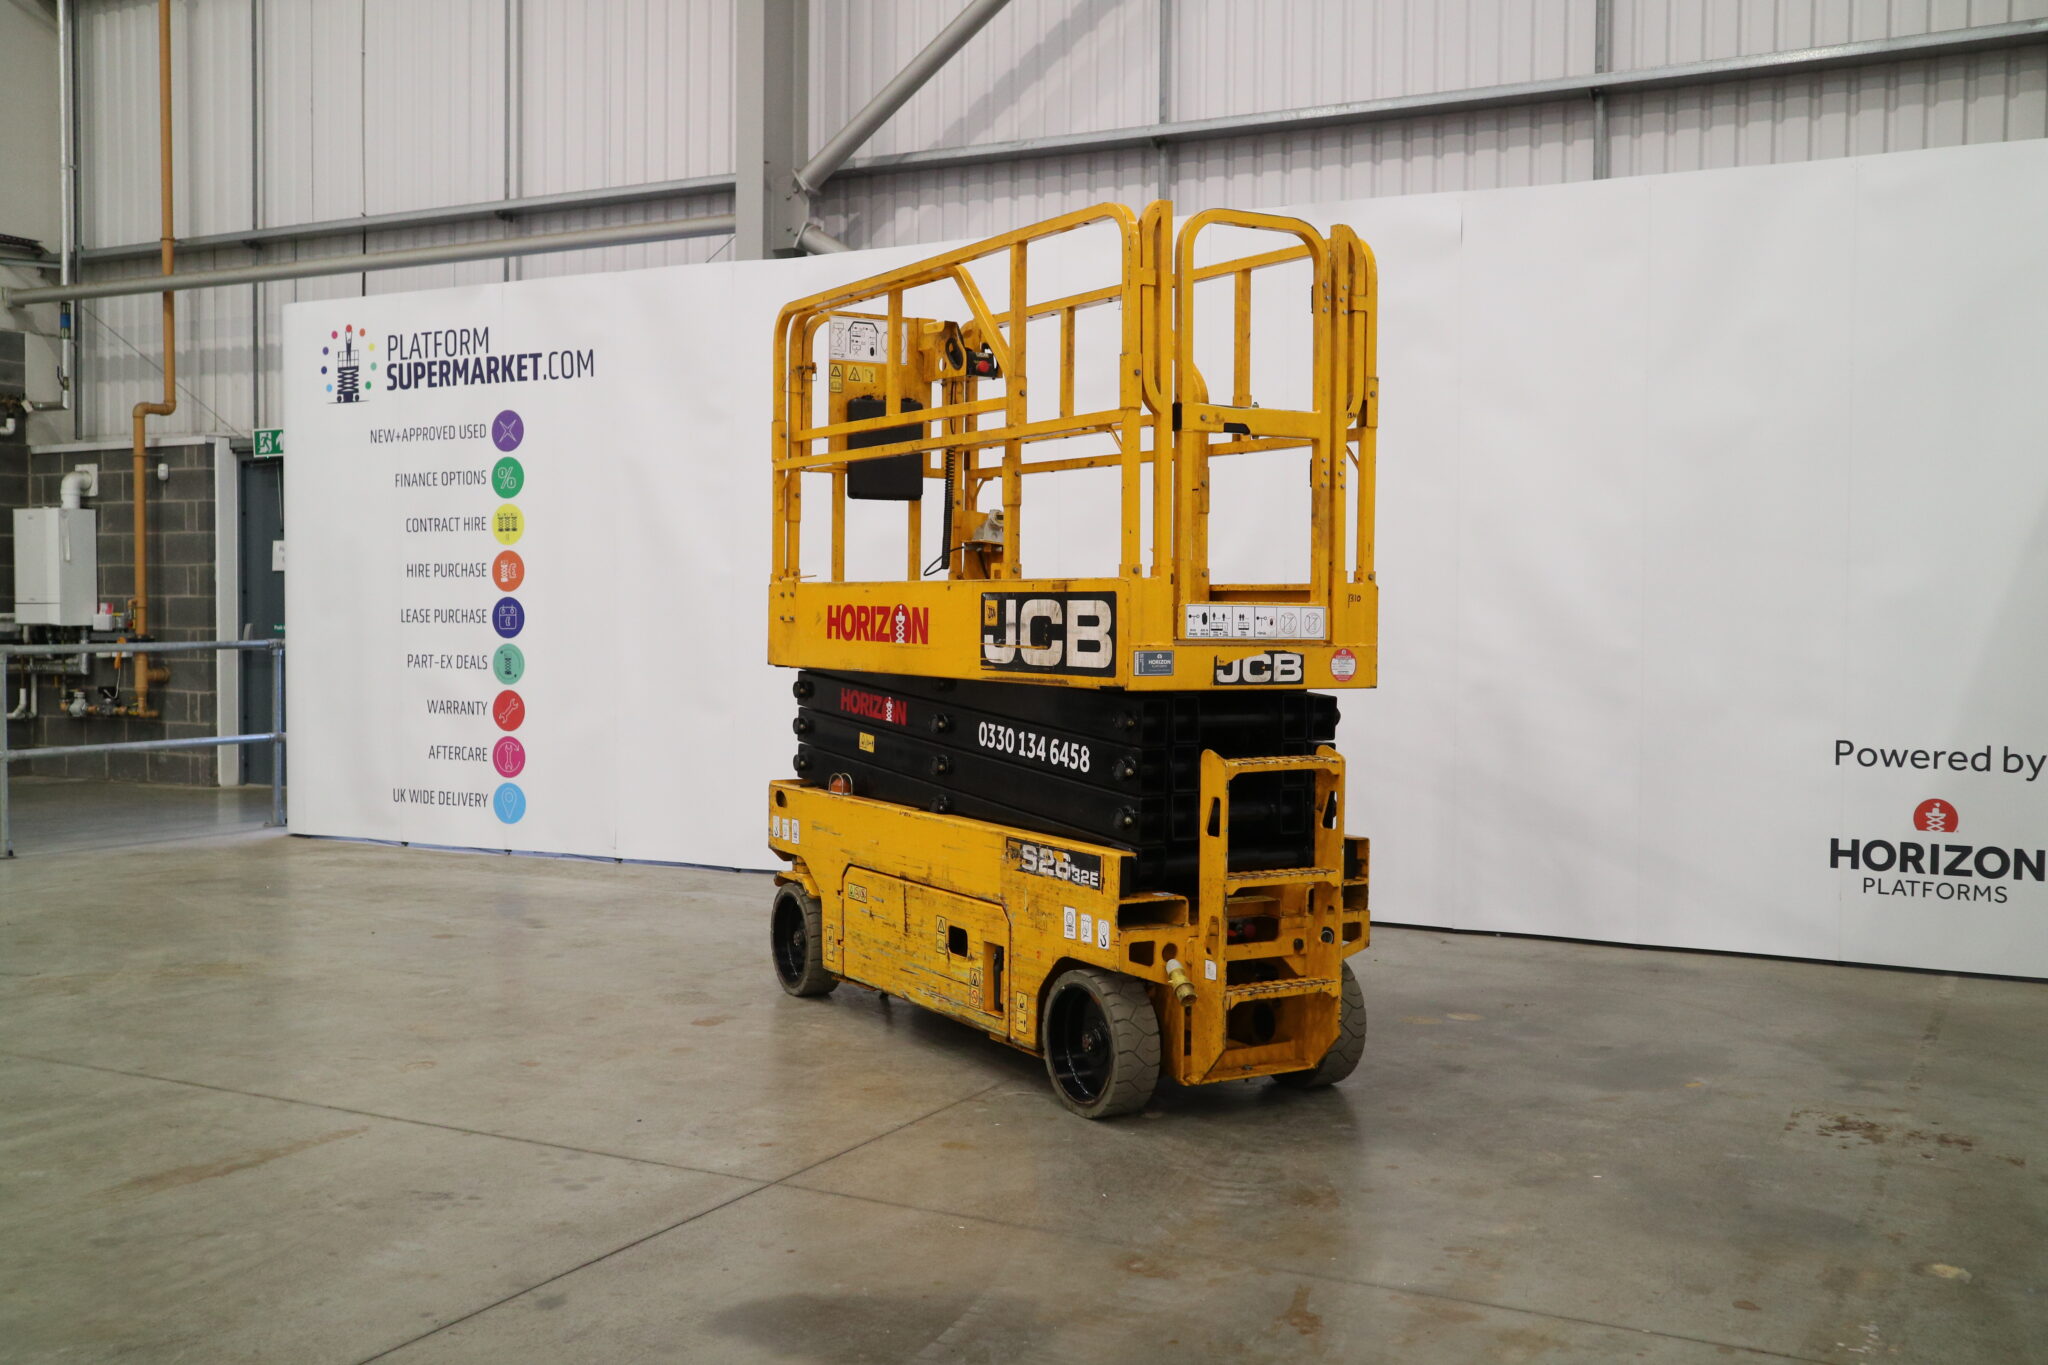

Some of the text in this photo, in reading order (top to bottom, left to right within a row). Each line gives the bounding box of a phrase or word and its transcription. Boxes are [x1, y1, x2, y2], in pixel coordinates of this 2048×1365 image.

[387, 327, 489, 361] PLATFORM
[386, 349, 595, 391] SUPERMARKET.COM
[370, 423, 487, 444] NEW+APPROVED USED
[395, 470, 487, 488] FINANCE OPTIONS
[405, 516, 487, 533] CONTRACT HIRE
[406, 562, 487, 578] HIRE PURCHASE
[400, 608, 487, 624] LEASE PURCHASE
[826, 603, 929, 645] HORIZON
[984, 599, 1112, 669] JCB
[407, 653, 488, 670] PART-EX DEALS
[1216, 653, 1302, 683] JCB
[426, 699, 488, 716] WARRANTY
[840, 687, 908, 726] HORIZON
[428, 745, 488, 762] AFTERCARE
[978, 721, 1091, 773] 0330 134 6458
[1834, 739, 2048, 782] Powered by
[392, 788, 489, 808] UK WIDE DELIVERY
[1829, 837, 2047, 882] HORIZON
[1862, 877, 2008, 904] PLATFORMS
